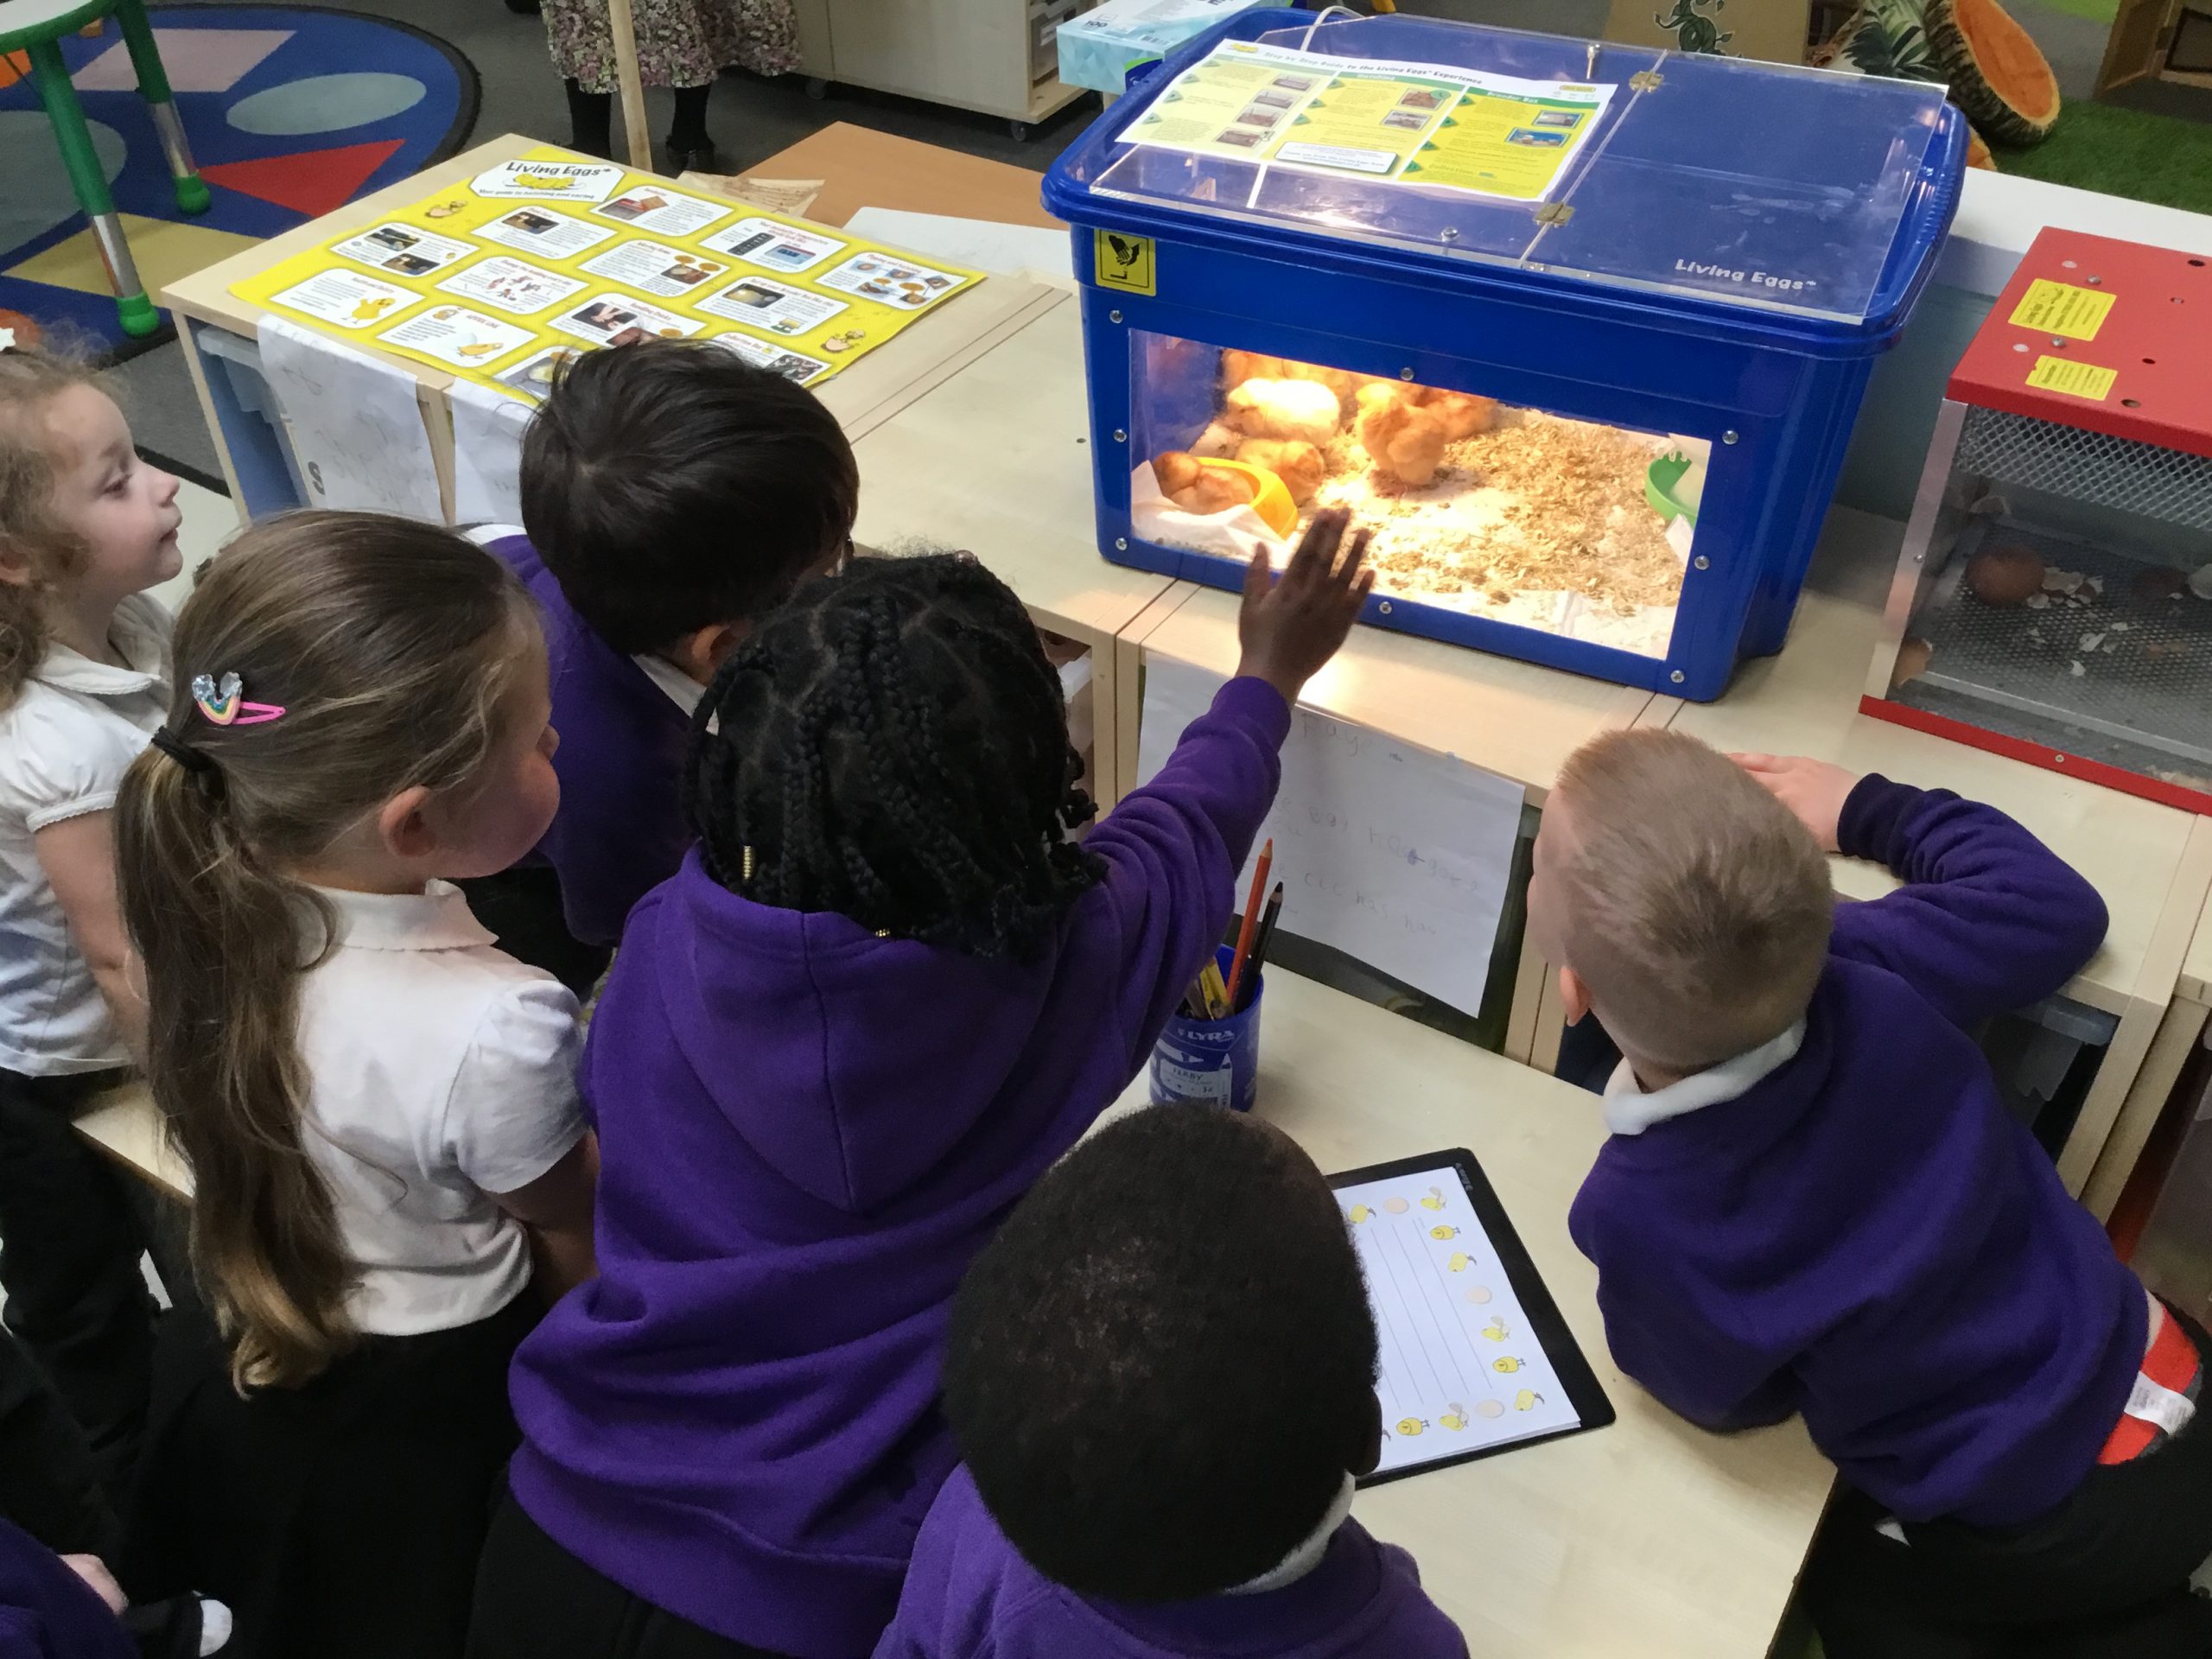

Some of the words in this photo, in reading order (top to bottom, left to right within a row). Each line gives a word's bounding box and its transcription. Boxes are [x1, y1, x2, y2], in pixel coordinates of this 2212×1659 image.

[1433, 71, 1483, 85] Experience
[505, 162, 560, 176] Living
[1675, 258, 1745, 282] Living
[1187, 1030, 1236, 1043] LYRA
